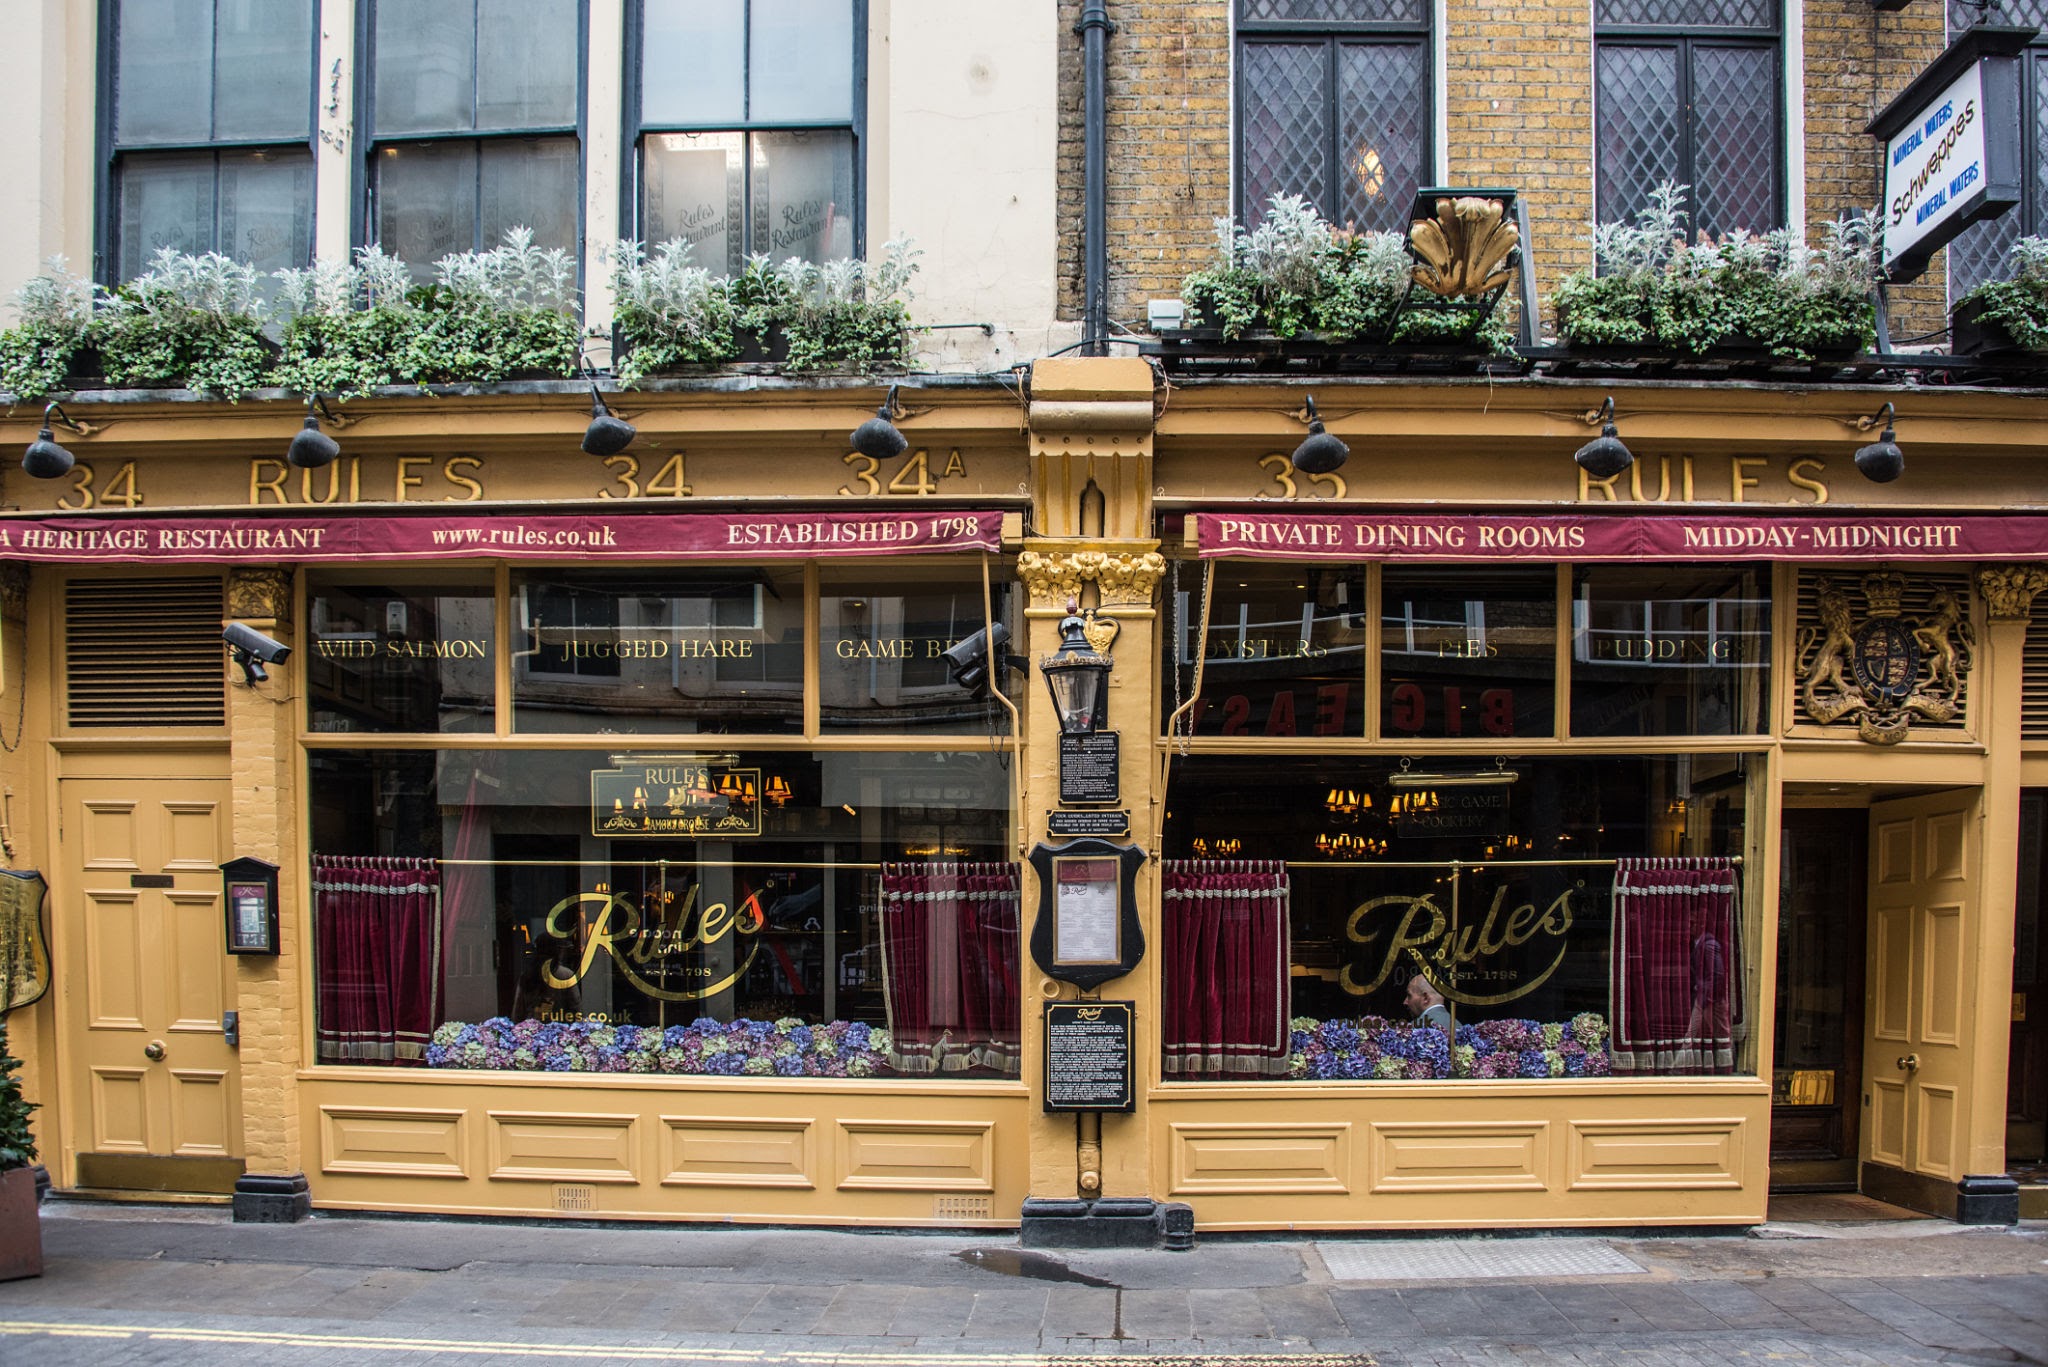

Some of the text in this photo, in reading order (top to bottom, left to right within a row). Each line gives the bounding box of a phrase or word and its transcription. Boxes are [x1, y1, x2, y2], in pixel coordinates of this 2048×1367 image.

[1893, 100, 1953, 167] MINERAL WATERS
[1892, 99, 1975, 225] Schweppes
[1916, 160, 1979, 226] MINERAL WATERS
[679, 203, 714, 229] Rules
[782, 200, 822, 226] Rules
[771, 217, 830, 250] Restauran
[58, 460, 144, 510] 34
[598, 452, 693, 499] 34
[21, 529, 148, 550] HERITAGE
[158, 527, 326, 550] RESTAURANT
[431, 526, 617, 547] www.rules.co.uk
[726, 516, 979, 545] ESTABLISHED 1798
[1219, 520, 1586, 549] PRIVATE DINING ROOMS
[1684, 525, 1962, 548] MIDDAY-MIDNIGHT
[318, 639, 487, 659] WILD SALMON
[560, 638, 753, 663] JUGGED HARE
[836, 639, 914, 659] GAME
[1438, 639, 1498, 658] PIES
[645, 767, 709, 785] RULE'S
[541, 883, 764, 1001] Rules
[1340, 884, 1574, 1006] Rules
[679, 967, 712, 977] 1798
[1482, 969, 1517, 981] 1798
[541, 1008, 633, 1025] rules.co.uk
